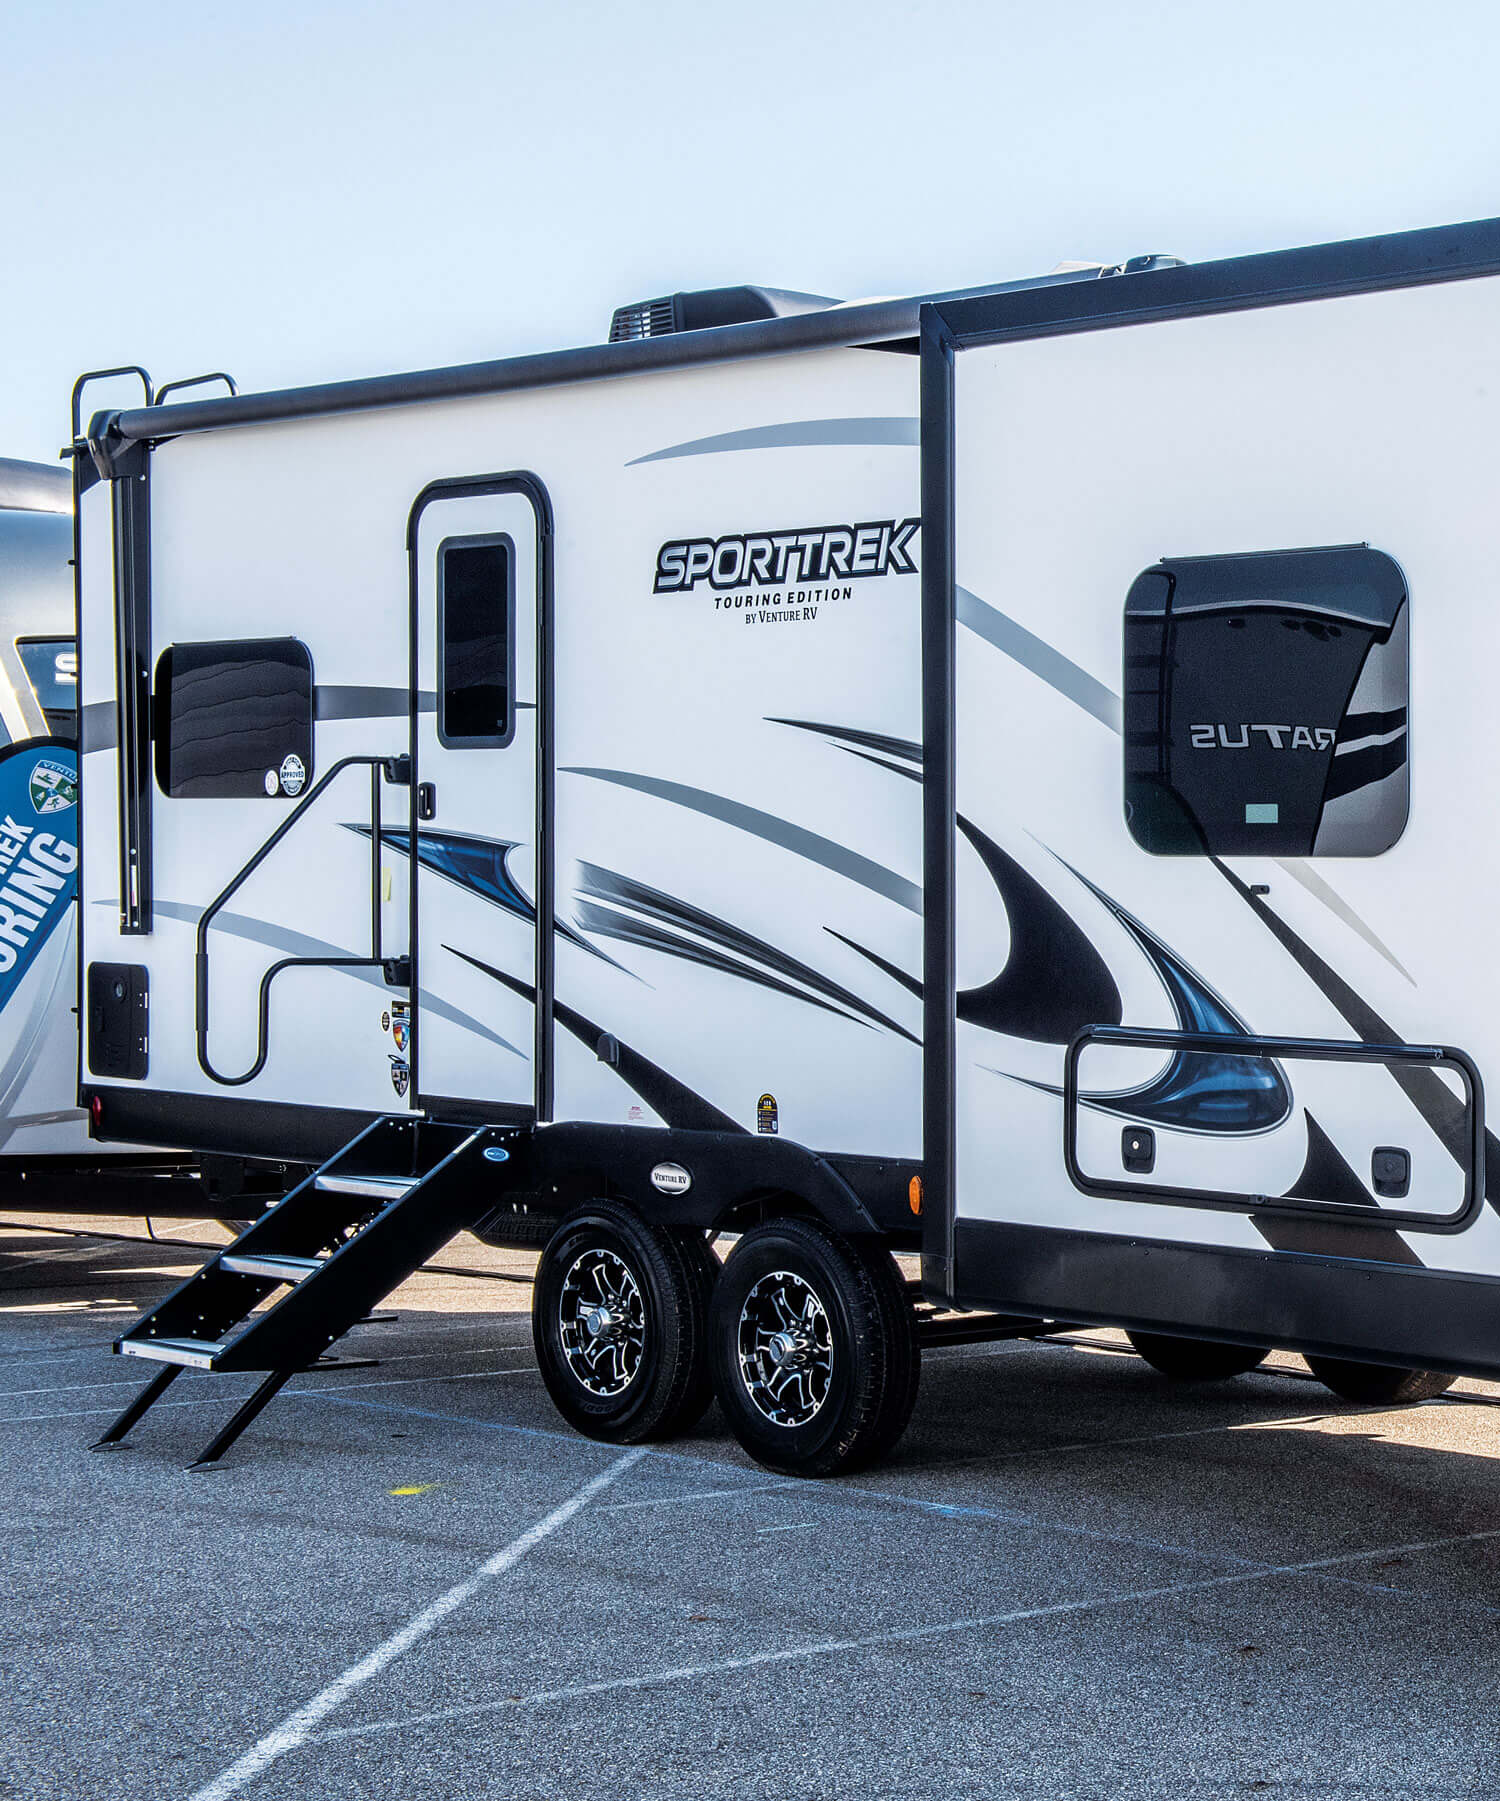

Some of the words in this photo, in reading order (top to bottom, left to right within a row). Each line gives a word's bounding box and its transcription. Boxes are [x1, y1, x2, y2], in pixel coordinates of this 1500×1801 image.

[653, 517, 921, 594] SPORTTREK
[714, 593, 781, 610] TOURING
[787, 586, 852, 603] EDITION
[803, 606, 818, 620] RV
